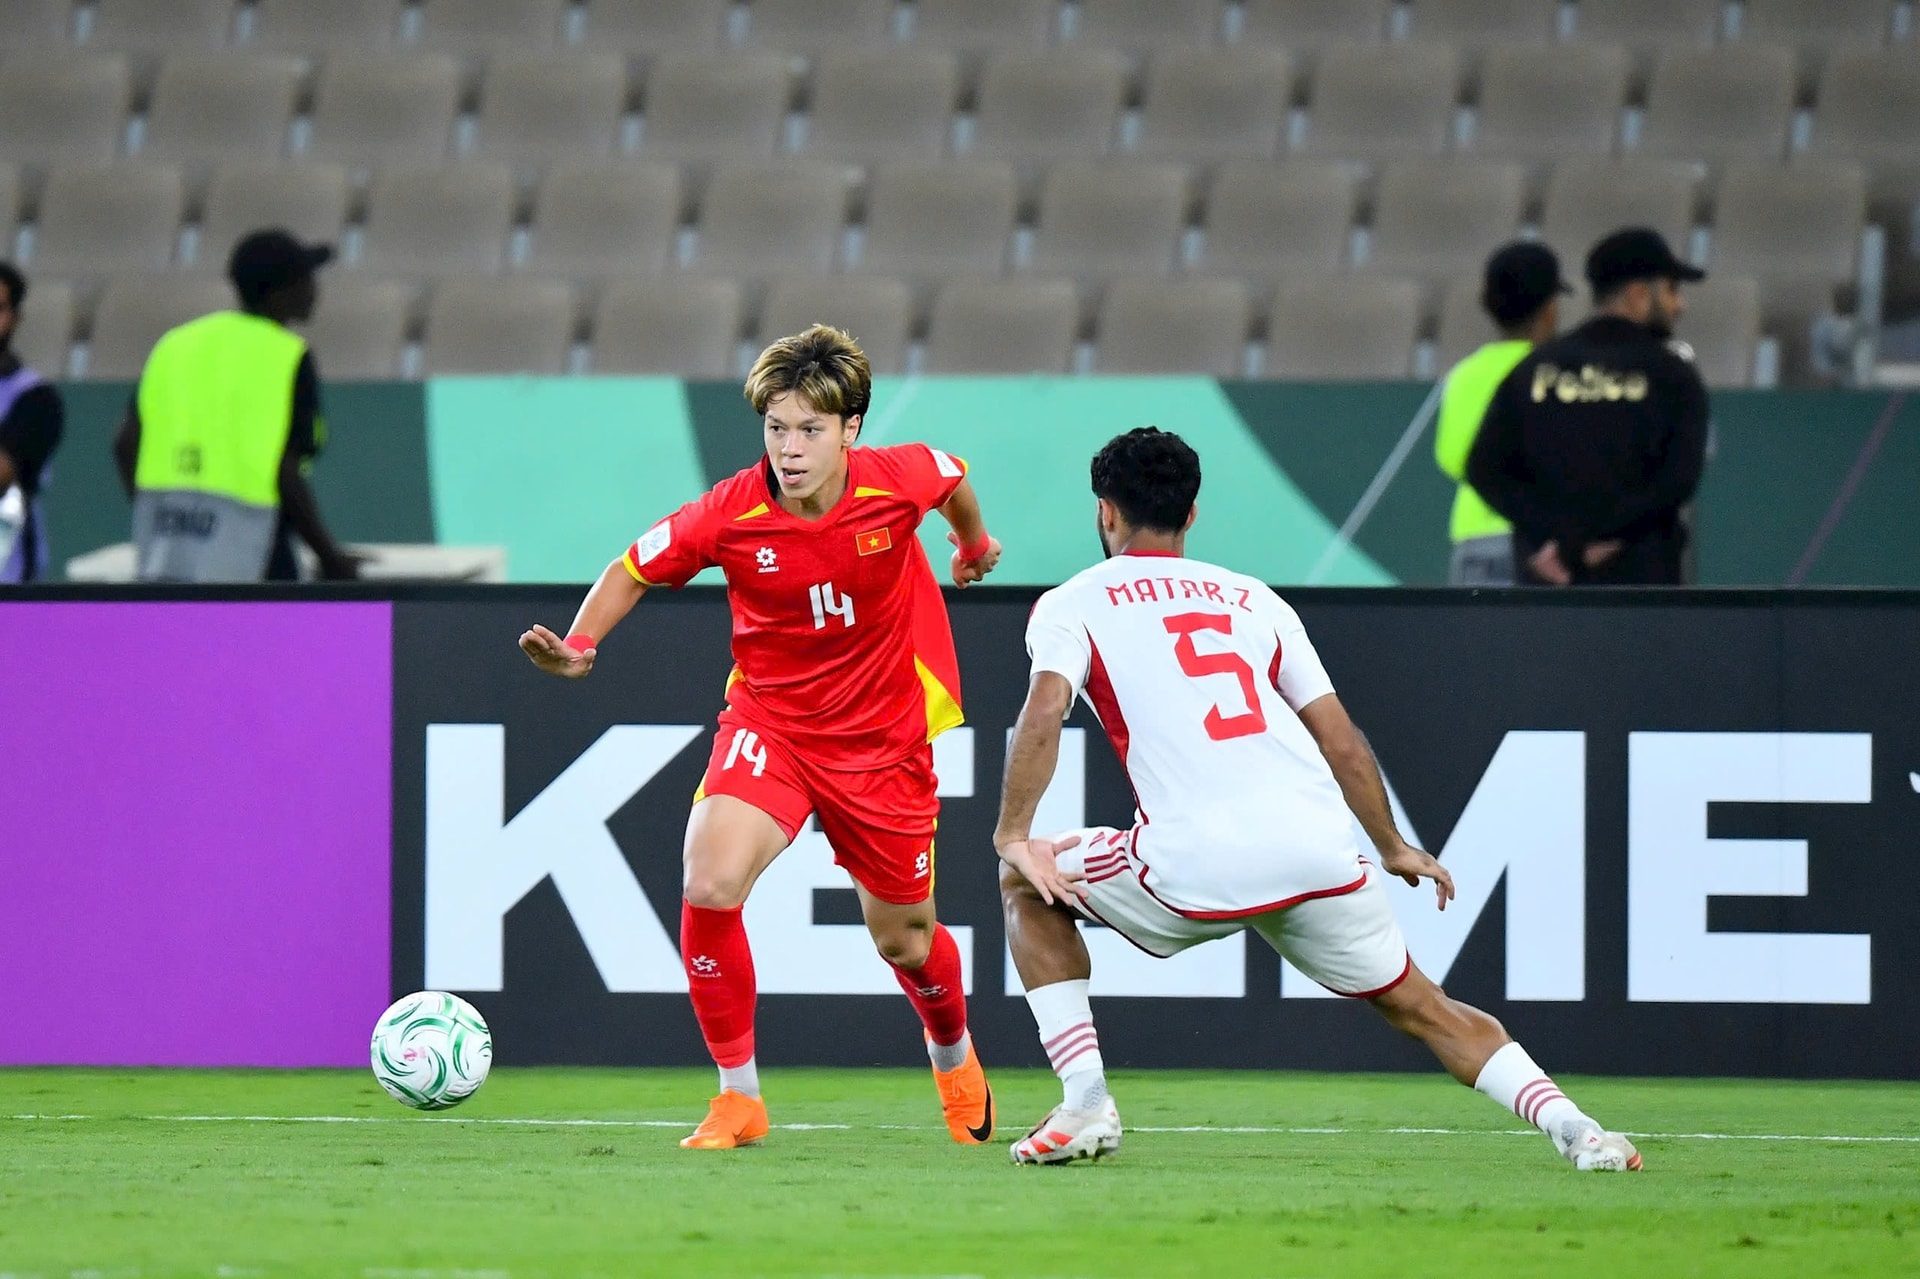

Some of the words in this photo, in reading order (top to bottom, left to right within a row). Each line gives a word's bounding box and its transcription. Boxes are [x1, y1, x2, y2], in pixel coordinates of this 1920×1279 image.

[808, 581, 856, 631] 14
[1105, 577, 1253, 613] MATAR.Z
[1162, 612, 1268, 741] 5
[722, 728, 767, 777] 14
